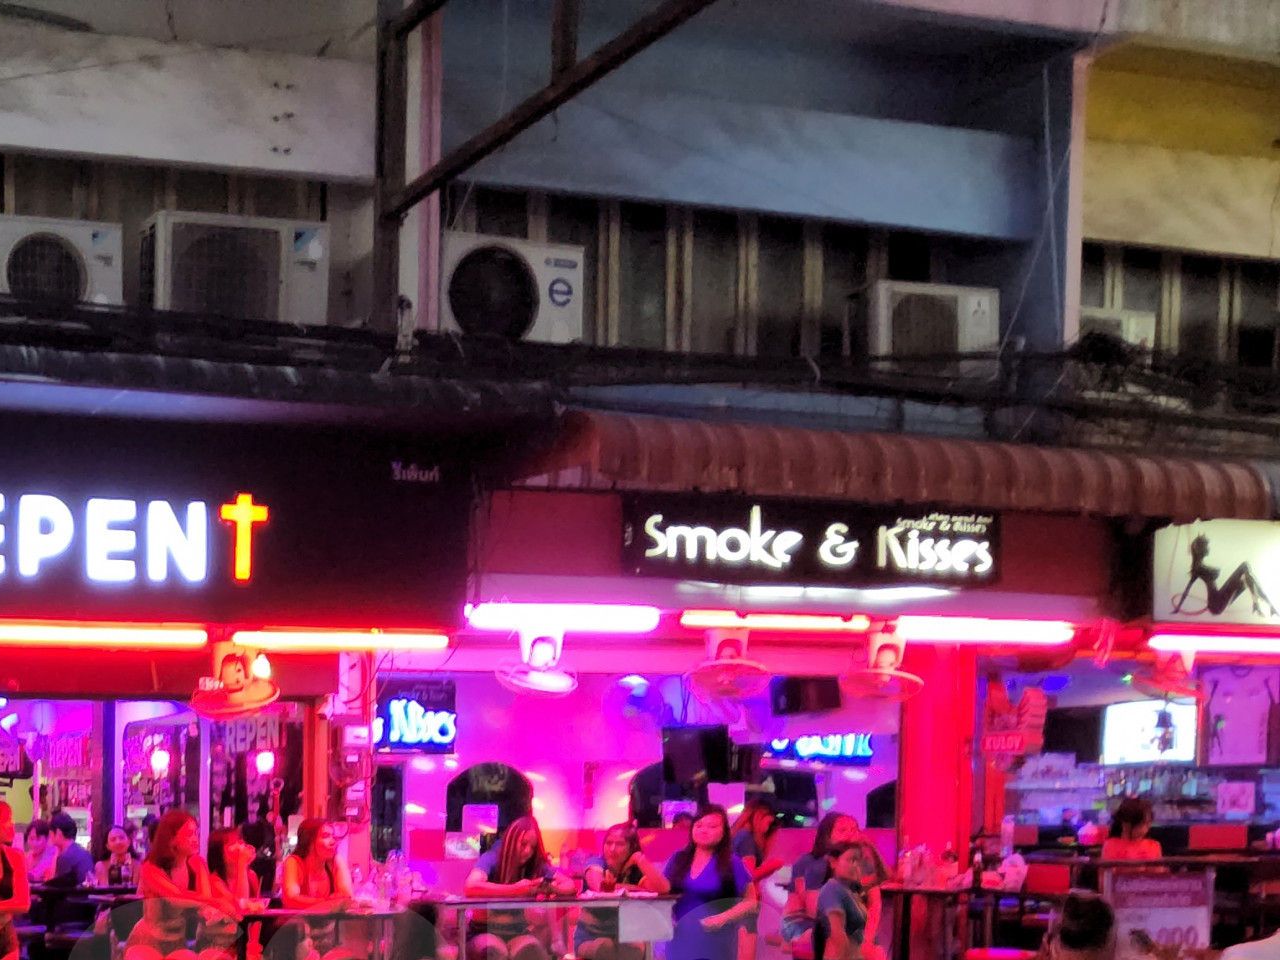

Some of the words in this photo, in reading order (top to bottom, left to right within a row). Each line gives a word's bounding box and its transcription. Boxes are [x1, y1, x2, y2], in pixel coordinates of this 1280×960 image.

[644, 505, 803, 568] Smoke
[819, 523, 859, 565] &
[877, 524, 993, 573] Kisses
